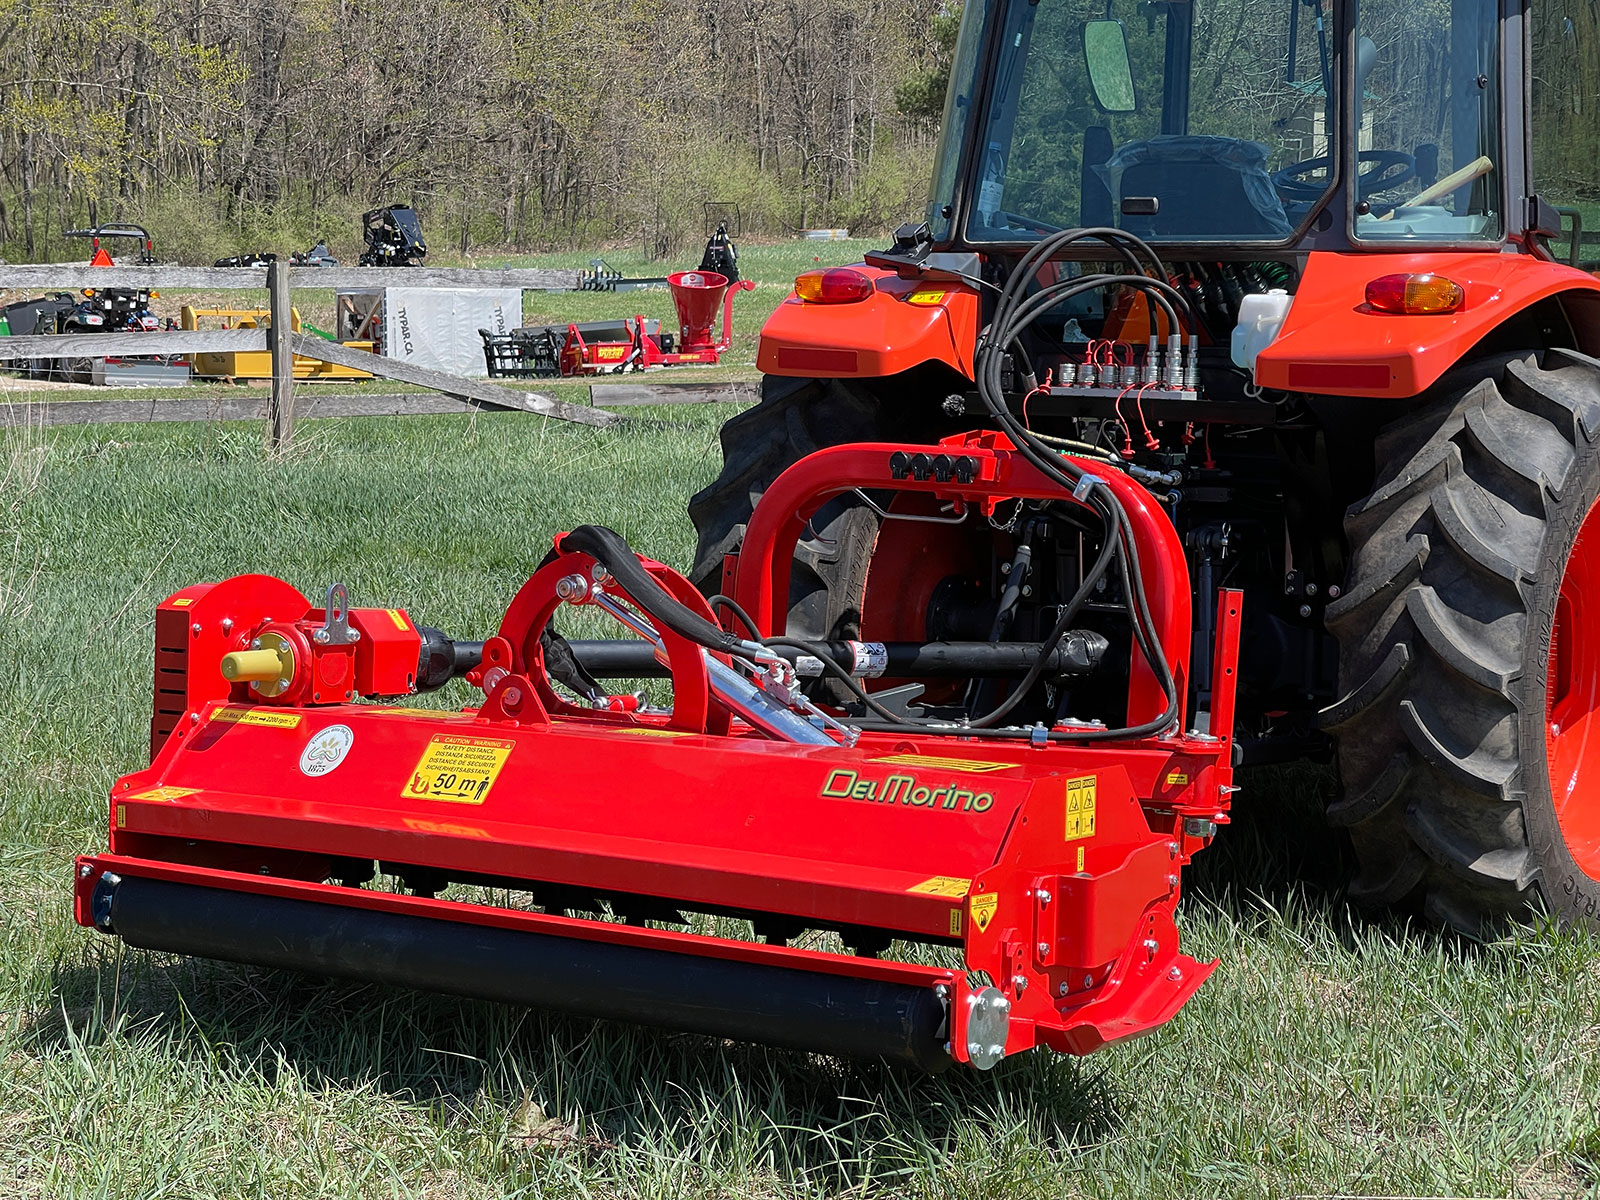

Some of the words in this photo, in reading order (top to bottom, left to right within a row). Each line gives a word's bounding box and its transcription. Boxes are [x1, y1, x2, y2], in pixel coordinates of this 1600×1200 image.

[398, 307, 414, 356] TYPAR.CA
[444, 737, 470, 745] CAUTION
[473, 739, 502, 748] WARNING
[442, 744, 466, 752] SAFETY
[466, 746, 496, 754] DISTANCE
[428, 757, 457, 765] DISTANCE
[435, 750, 463, 759] DISTANZA
[464, 753, 497, 761] SICUREZZA
[425, 764, 490, 775] SICHERHEITSABSTAND
[433, 773, 457, 789] 50
[458, 778, 477, 792] m
[976, 896, 993, 904] DANGER
